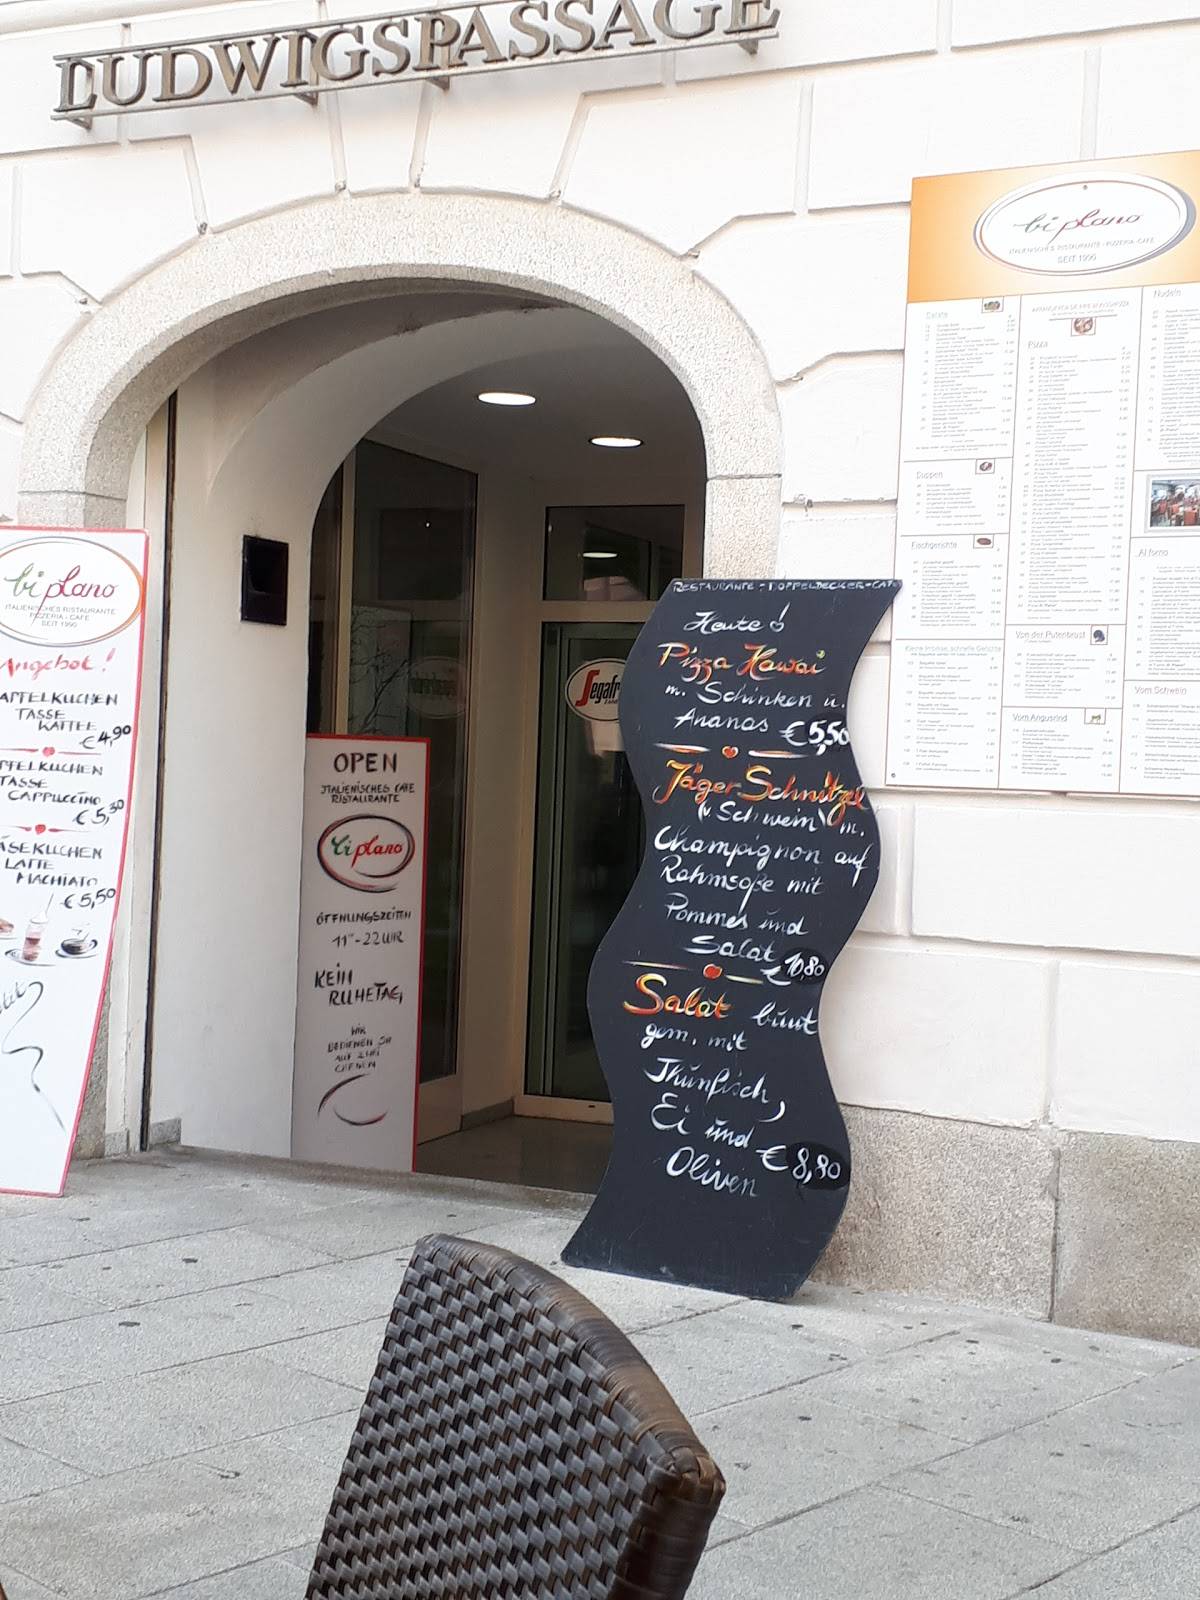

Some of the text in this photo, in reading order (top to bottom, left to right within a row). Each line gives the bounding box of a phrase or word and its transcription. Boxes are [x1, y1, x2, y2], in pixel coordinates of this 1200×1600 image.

[56, 0, 780, 113] LUDWIGSPASSAGE
[657, 642, 733, 684] Pizza
[696, 681, 812, 708] Schinken
[16, 708, 66, 720] TASSE
[673, 707, 769, 732] Ananas
[0, 760, 103, 776] PFELKUCHEN
[333, 752, 397, 773] OPEN
[0, 776, 48, 789] TASSE
[654, 825, 823, 871] Champignon
[786, 877, 823, 895] mit
[664, 892, 748, 930] Pommes
[684, 935, 778, 962] Salat
[623, 972, 733, 1020] Salat
[707, 1031, 749, 1051] mit
[650, 1091, 692, 1135] Ei
[665, 1146, 760, 1197] Oliven
